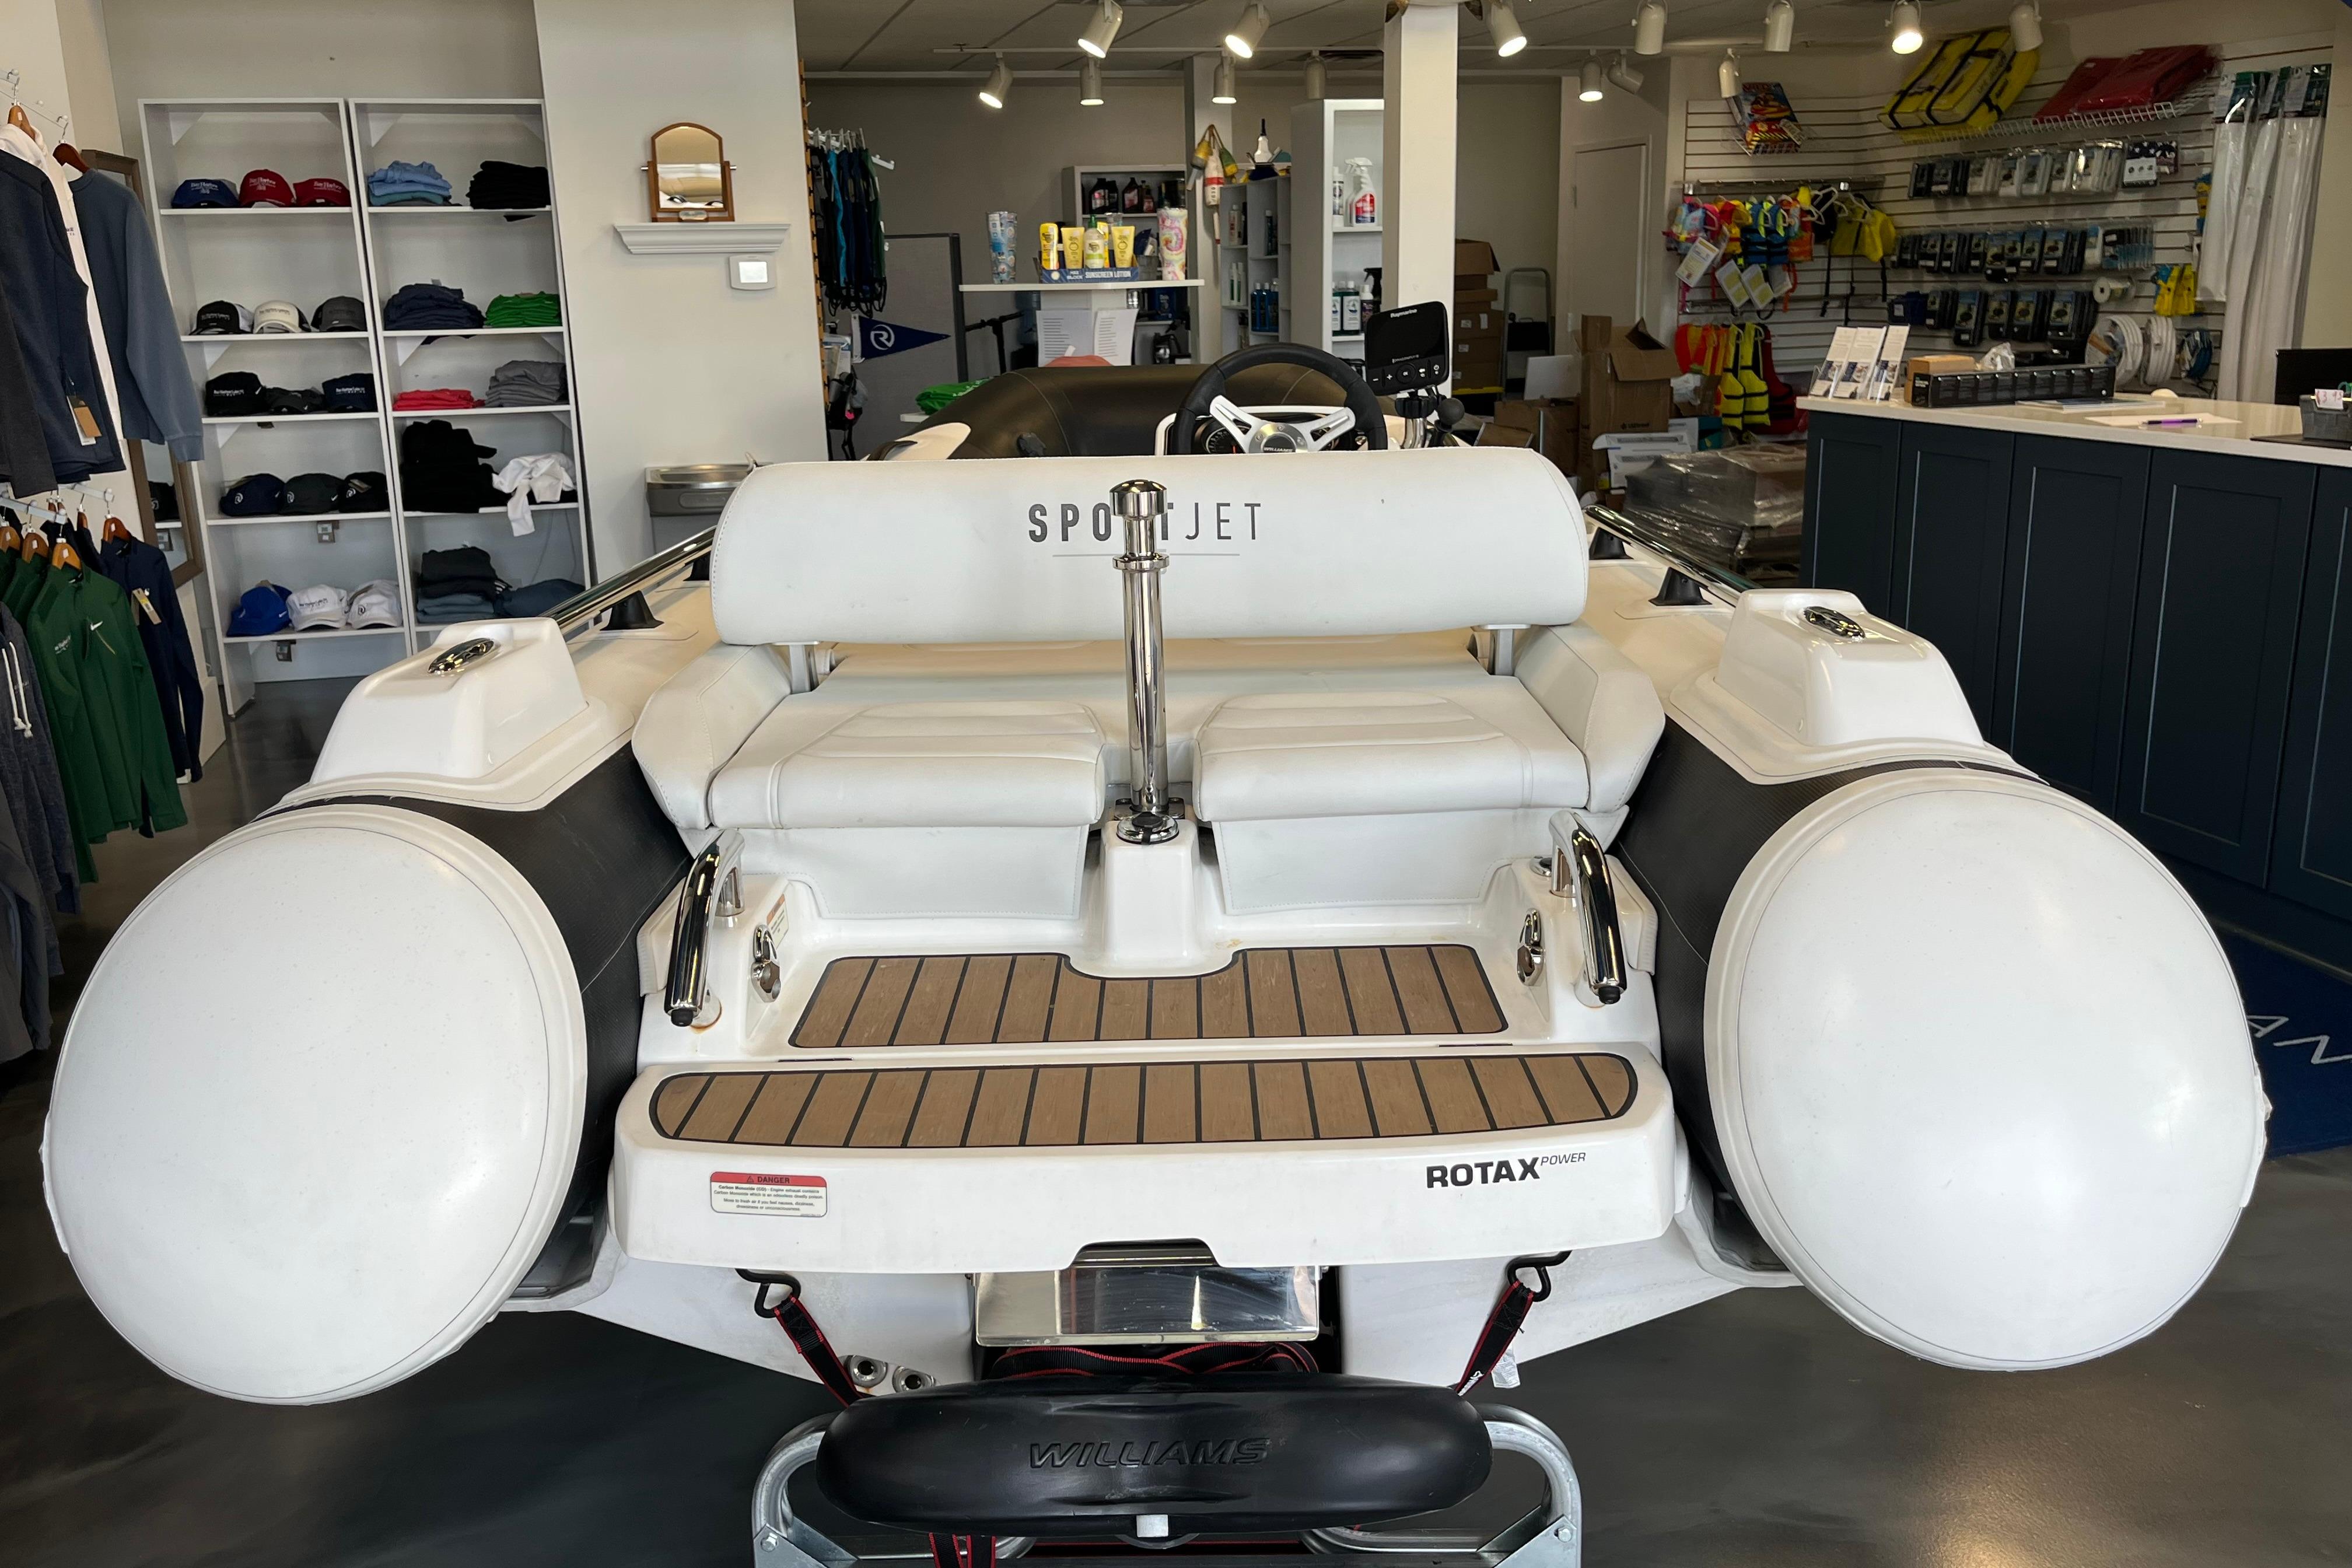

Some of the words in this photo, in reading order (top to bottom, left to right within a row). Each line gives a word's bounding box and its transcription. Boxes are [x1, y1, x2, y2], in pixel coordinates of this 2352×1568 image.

[1028, 502, 1261, 543] SPOTJET
[1426, 1157, 1540, 1188] ROTAX
[1541, 1152, 1586, 1166] POWER
[1030, 1437, 1270, 1469] WILLIAMS
